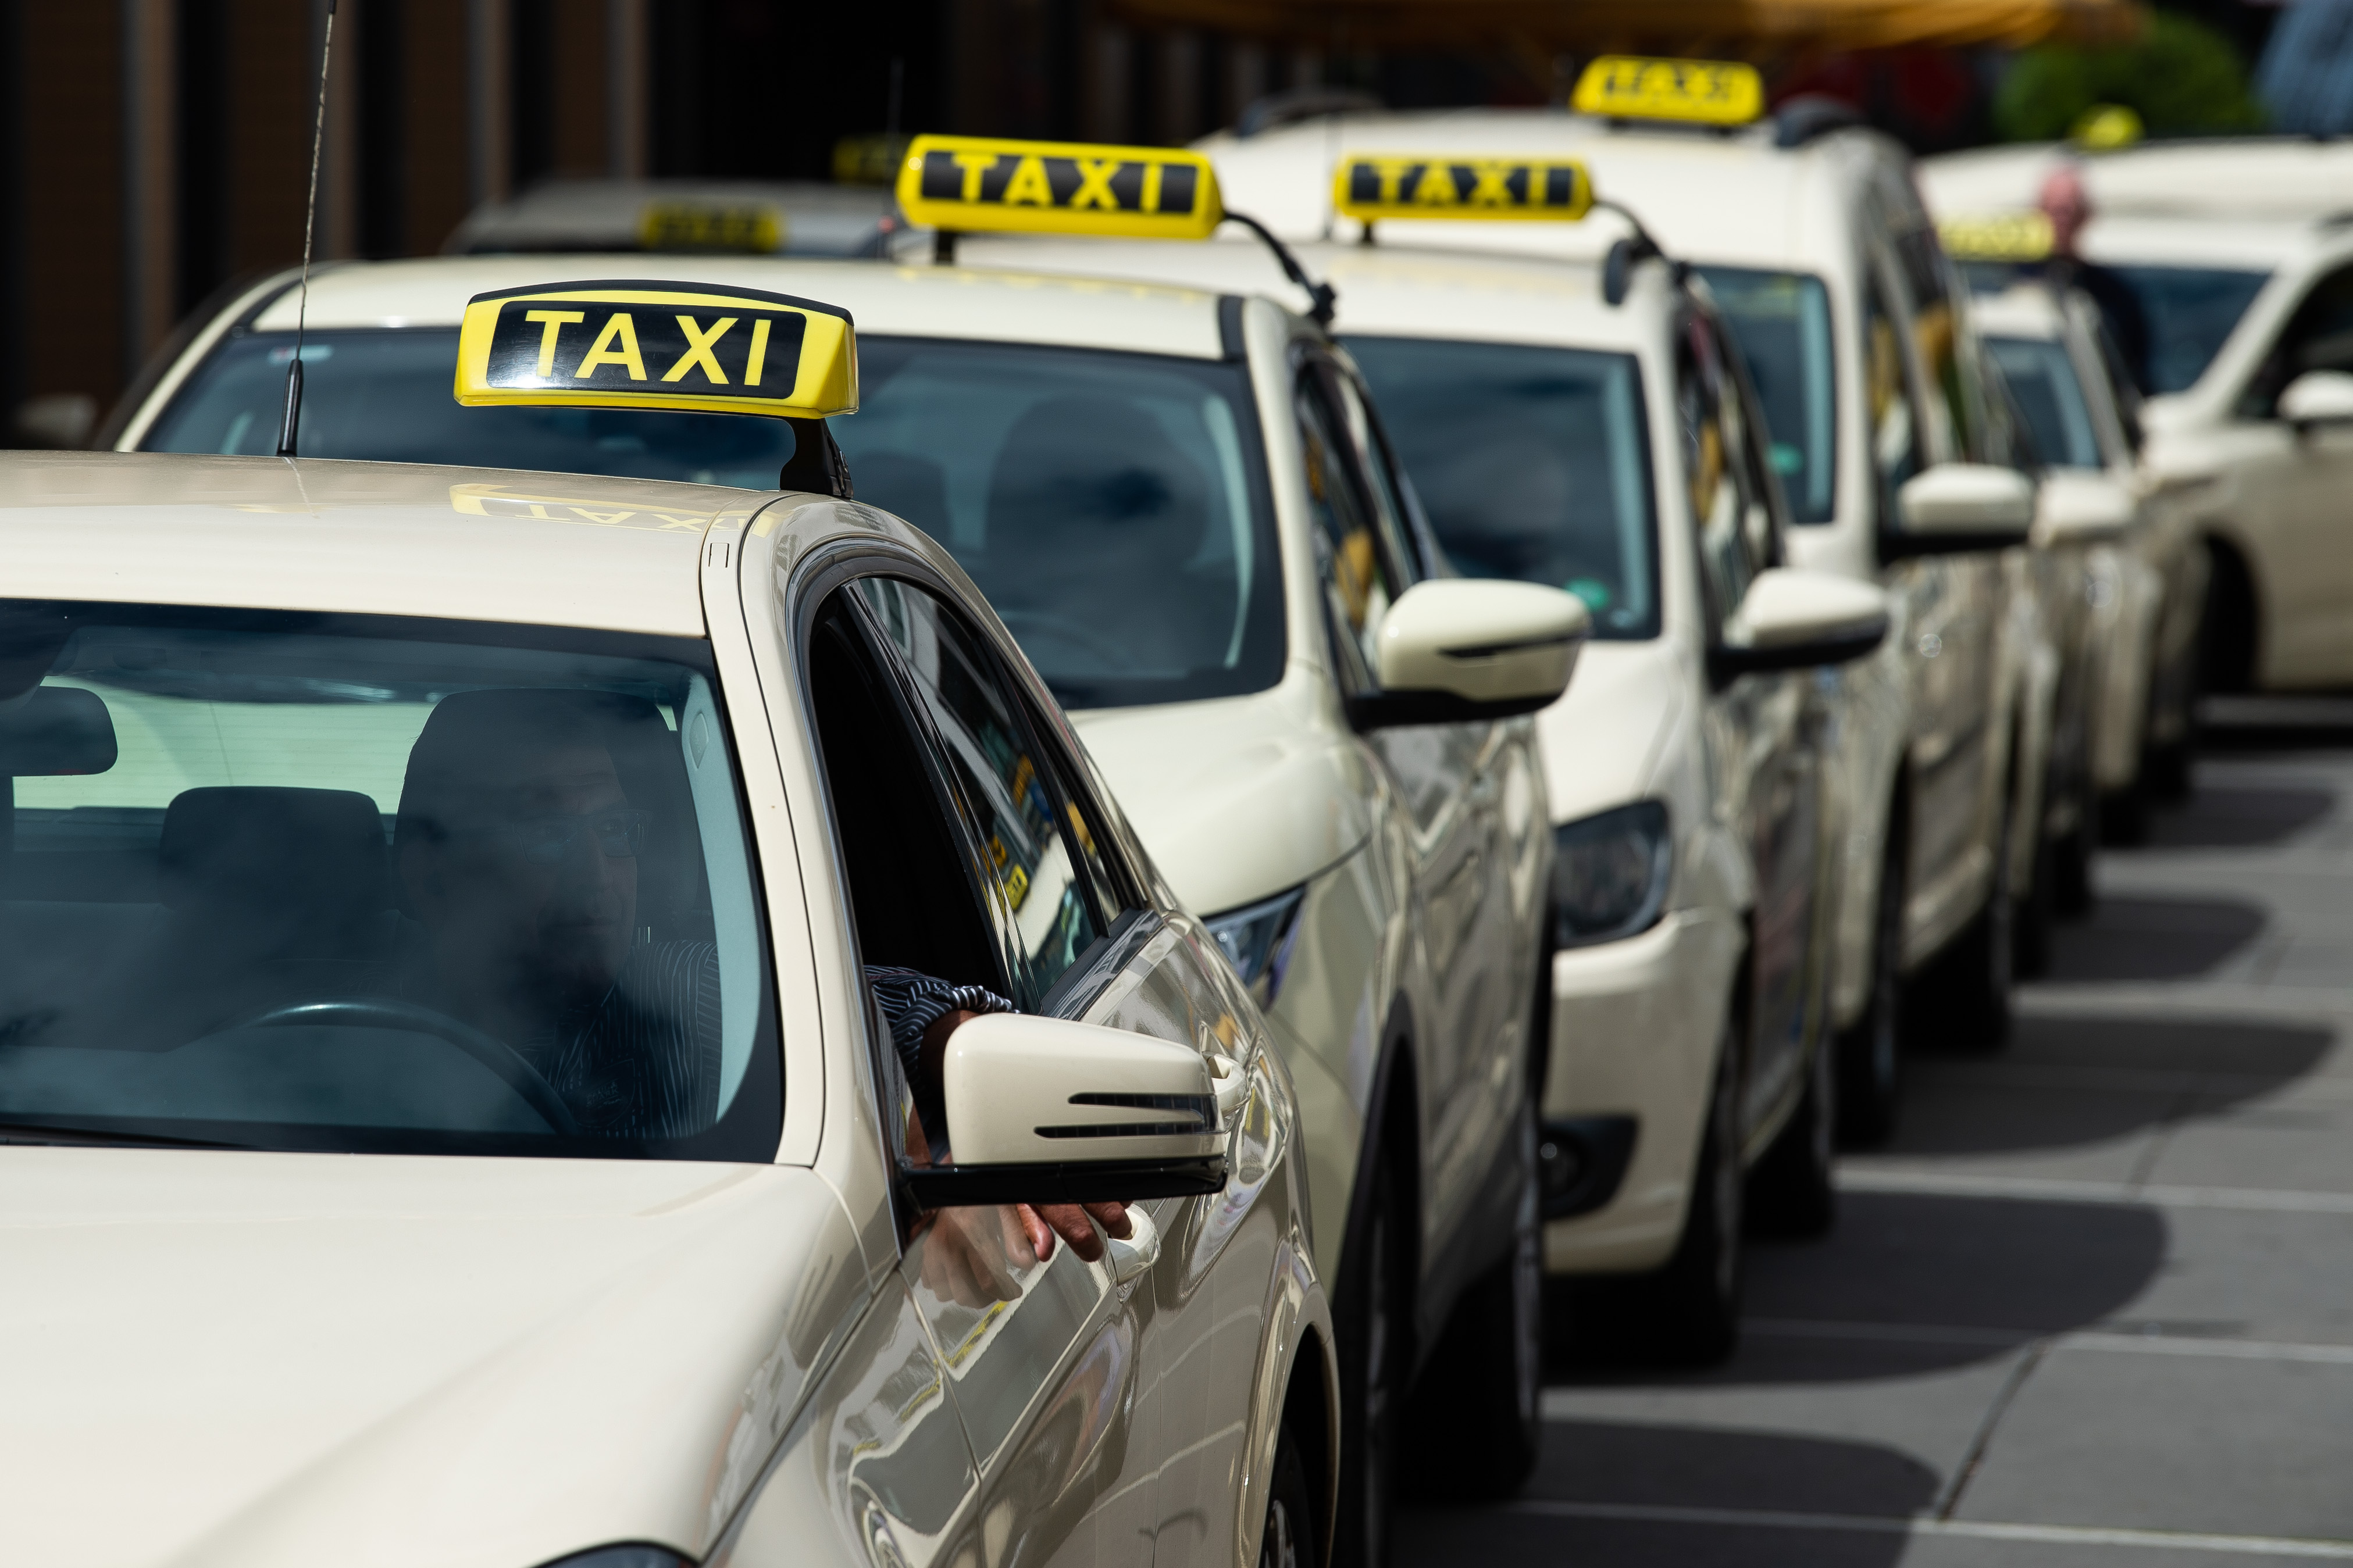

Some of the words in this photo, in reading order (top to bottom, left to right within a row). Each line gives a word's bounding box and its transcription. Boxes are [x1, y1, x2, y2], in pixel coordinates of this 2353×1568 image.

[953, 153, 1163, 212] TAXI
[1372, 161, 1548, 206] TAXI
[525, 310, 772, 386] TAXI
